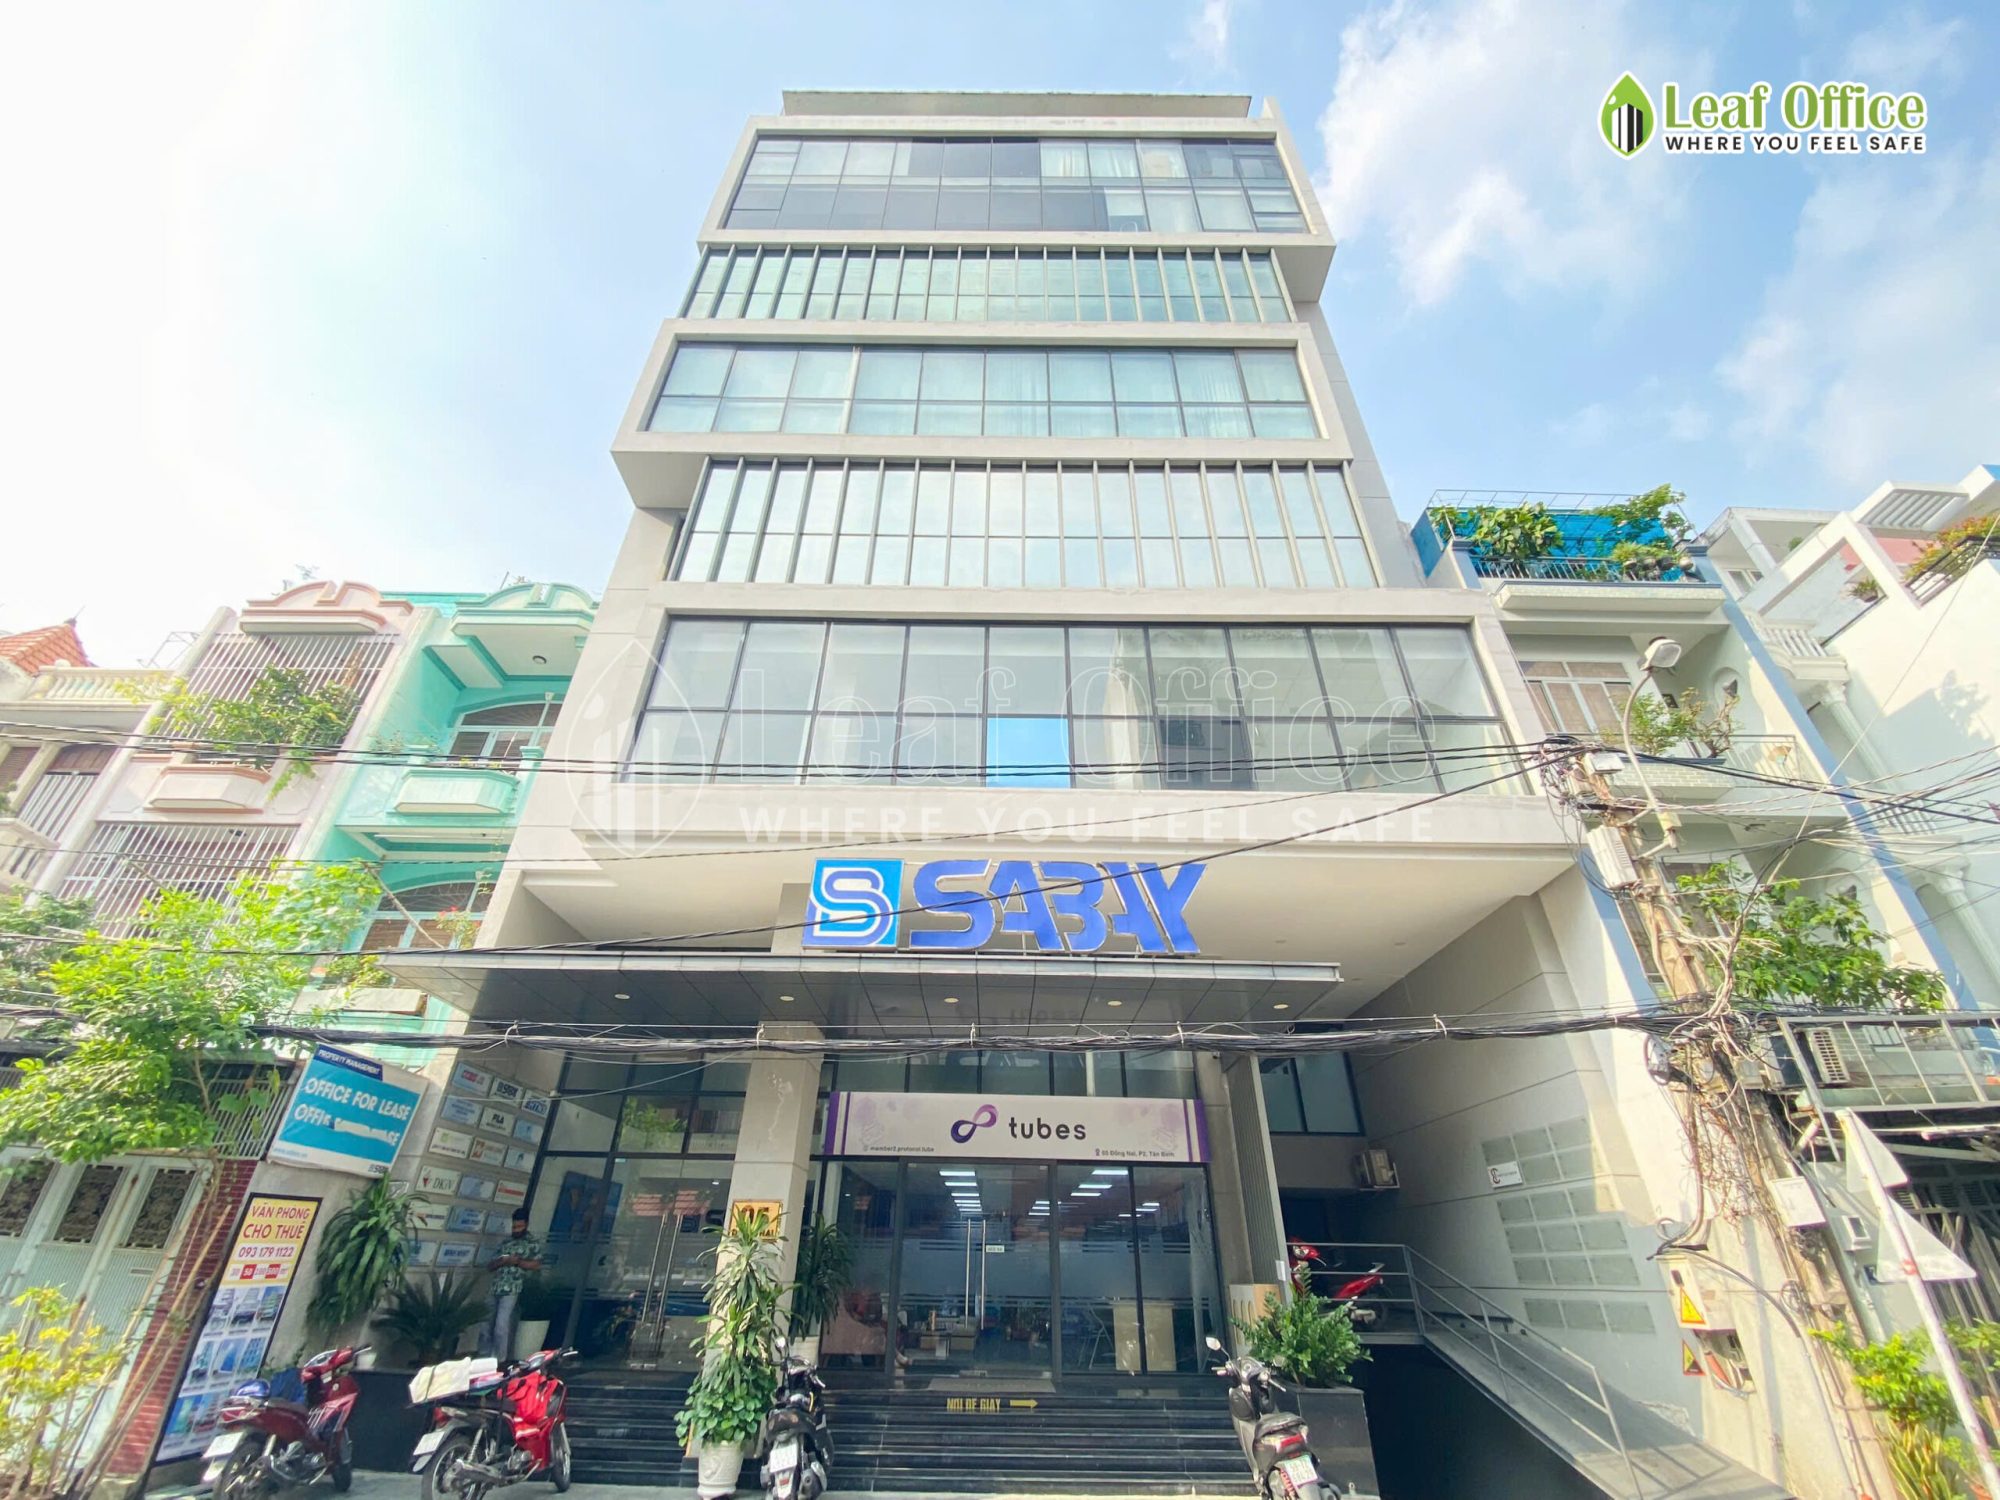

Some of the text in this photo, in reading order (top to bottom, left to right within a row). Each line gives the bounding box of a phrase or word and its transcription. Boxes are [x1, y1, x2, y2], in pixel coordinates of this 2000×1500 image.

[908, 858, 1208, 954] SABAY
[318, 1049, 381, 1075] PROPERTY MANAGEMENT
[305, 1077, 411, 1121] OFFICE FOR LEASE
[1008, 1117, 1087, 1141] tubes
[243, 1223, 272, 1239] CHO
[239, 1246, 296, 1258] 093 179 1122
